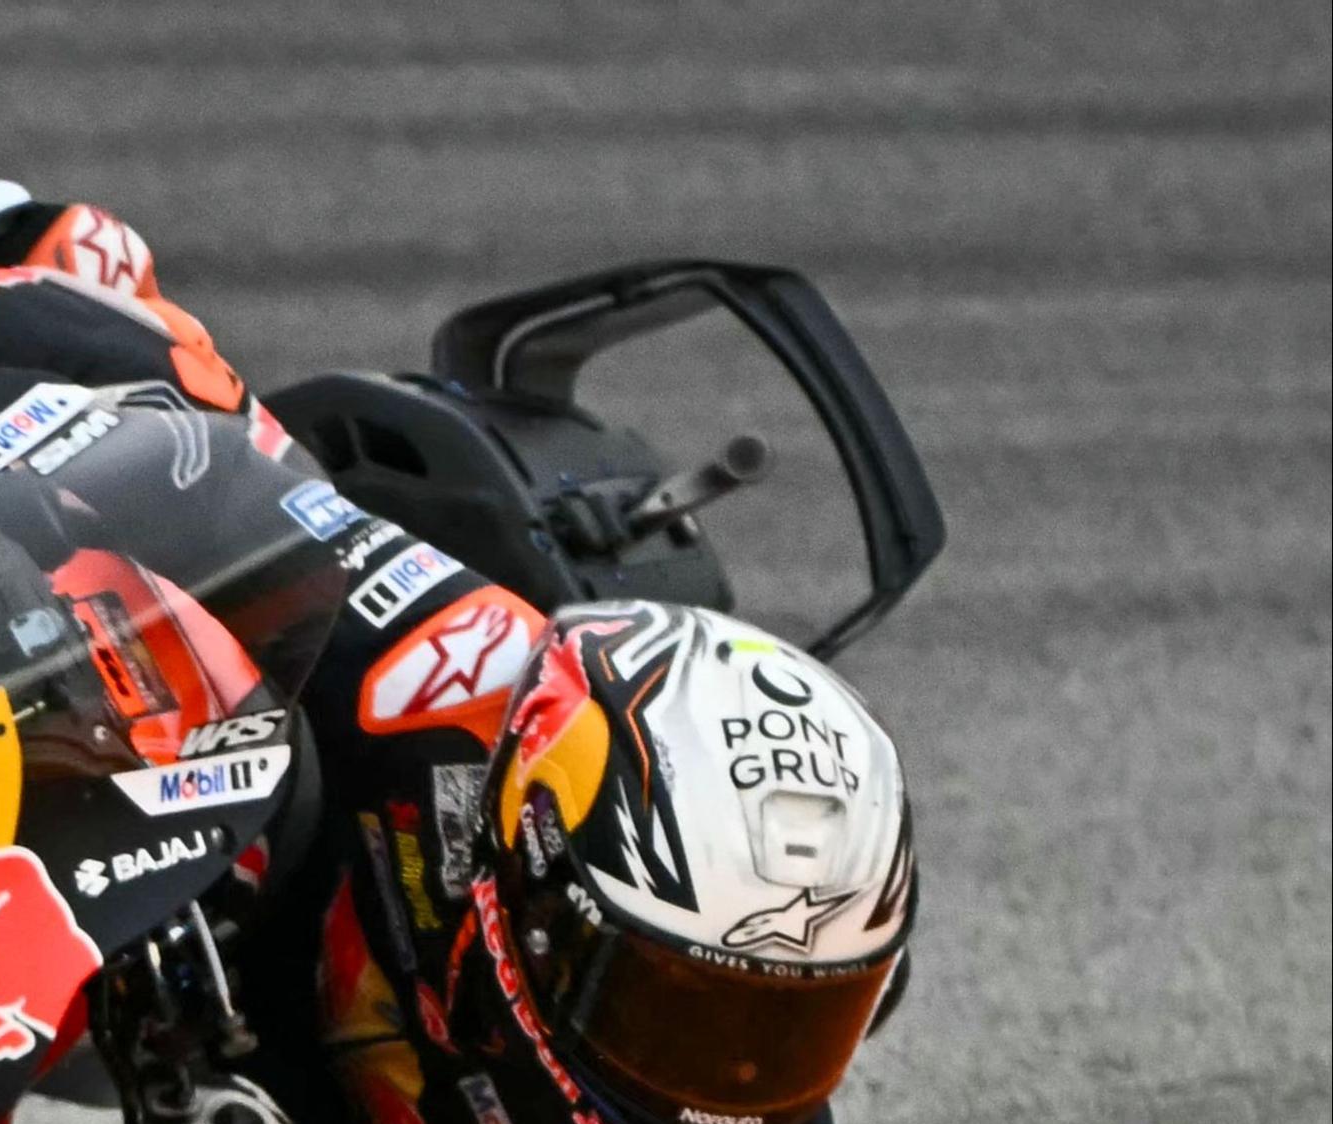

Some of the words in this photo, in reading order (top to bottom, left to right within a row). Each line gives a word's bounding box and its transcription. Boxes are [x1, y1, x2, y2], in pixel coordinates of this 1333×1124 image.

[176, 708, 286, 759] WRS
[721, 708, 850, 759] PONT
[159, 763, 225, 803] Mobil
[113, 831, 207, 884] BAJAJ
[688, 944, 750, 972] GIVES
[761, 961, 804, 978] YOU
